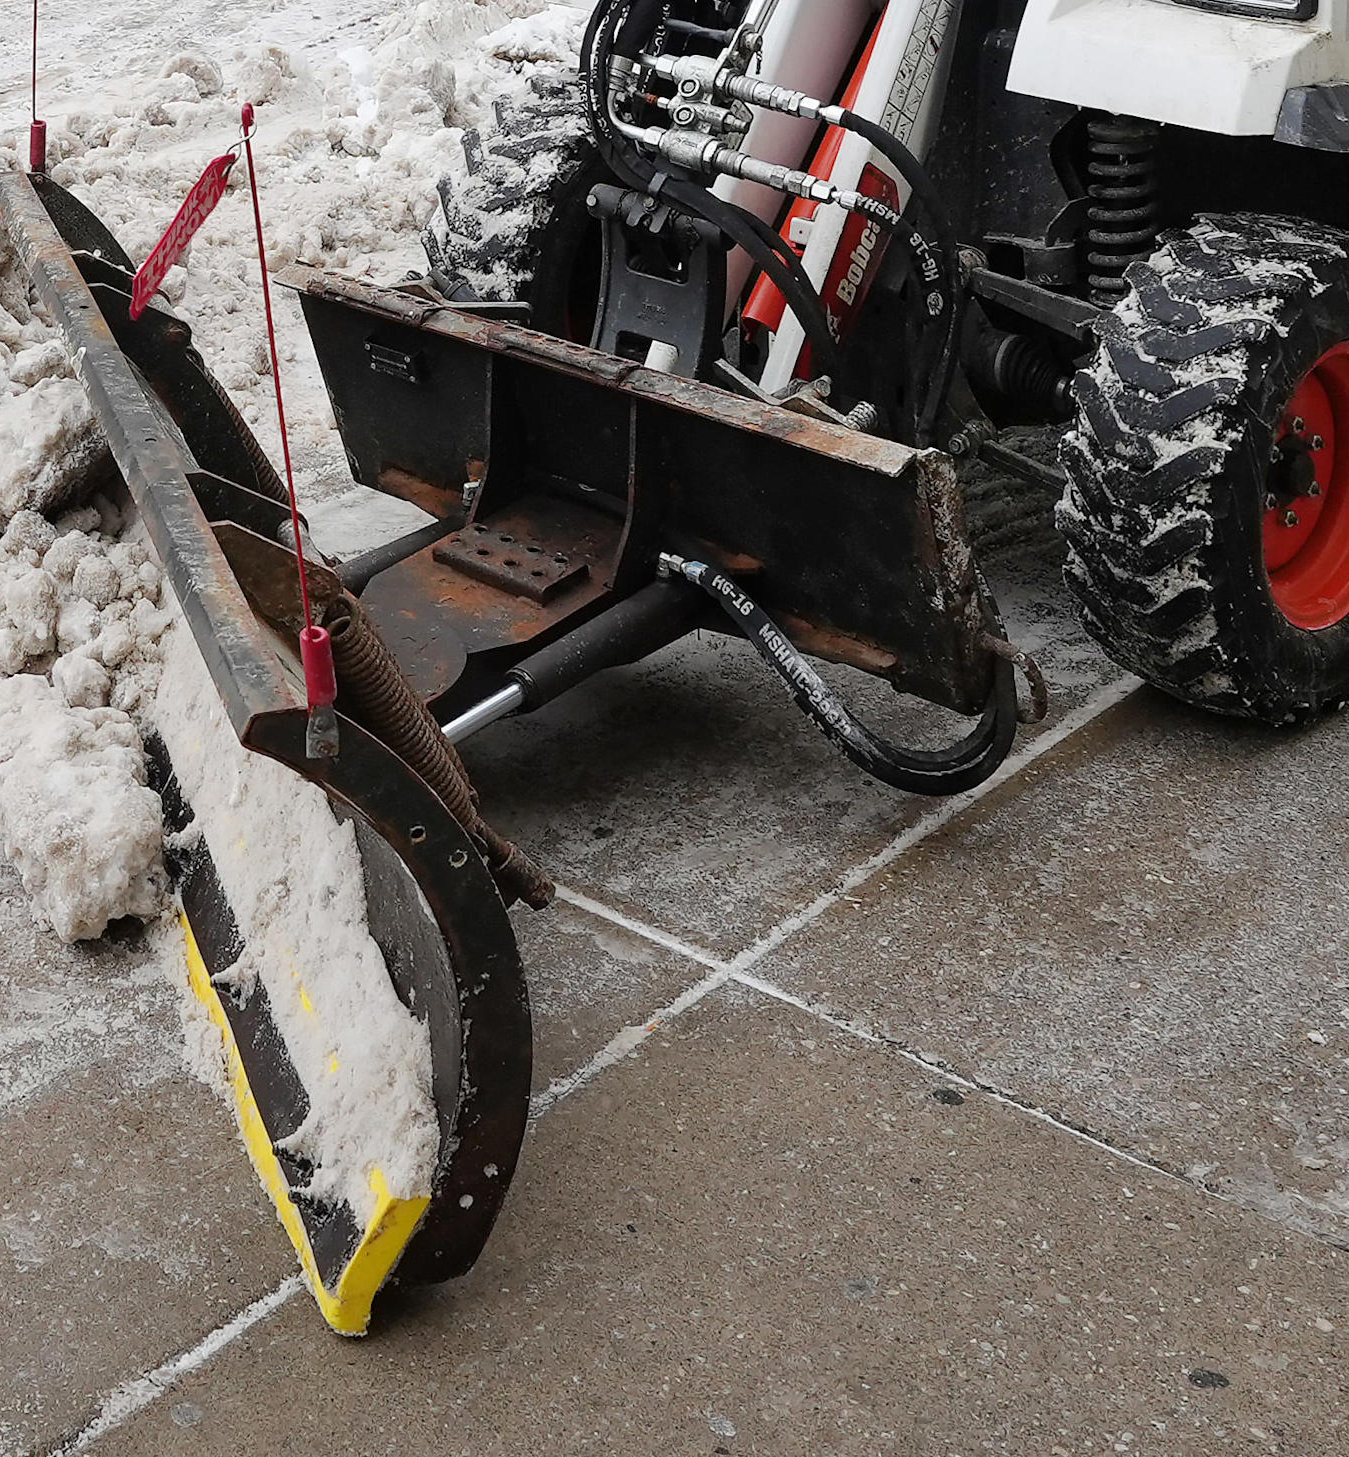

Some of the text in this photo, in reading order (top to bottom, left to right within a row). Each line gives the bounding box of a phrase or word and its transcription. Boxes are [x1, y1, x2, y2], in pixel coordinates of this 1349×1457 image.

[909, 232, 940, 281] HG-16
[712, 574, 754, 615] HG-16
[758, 623, 797, 673] MSHA
